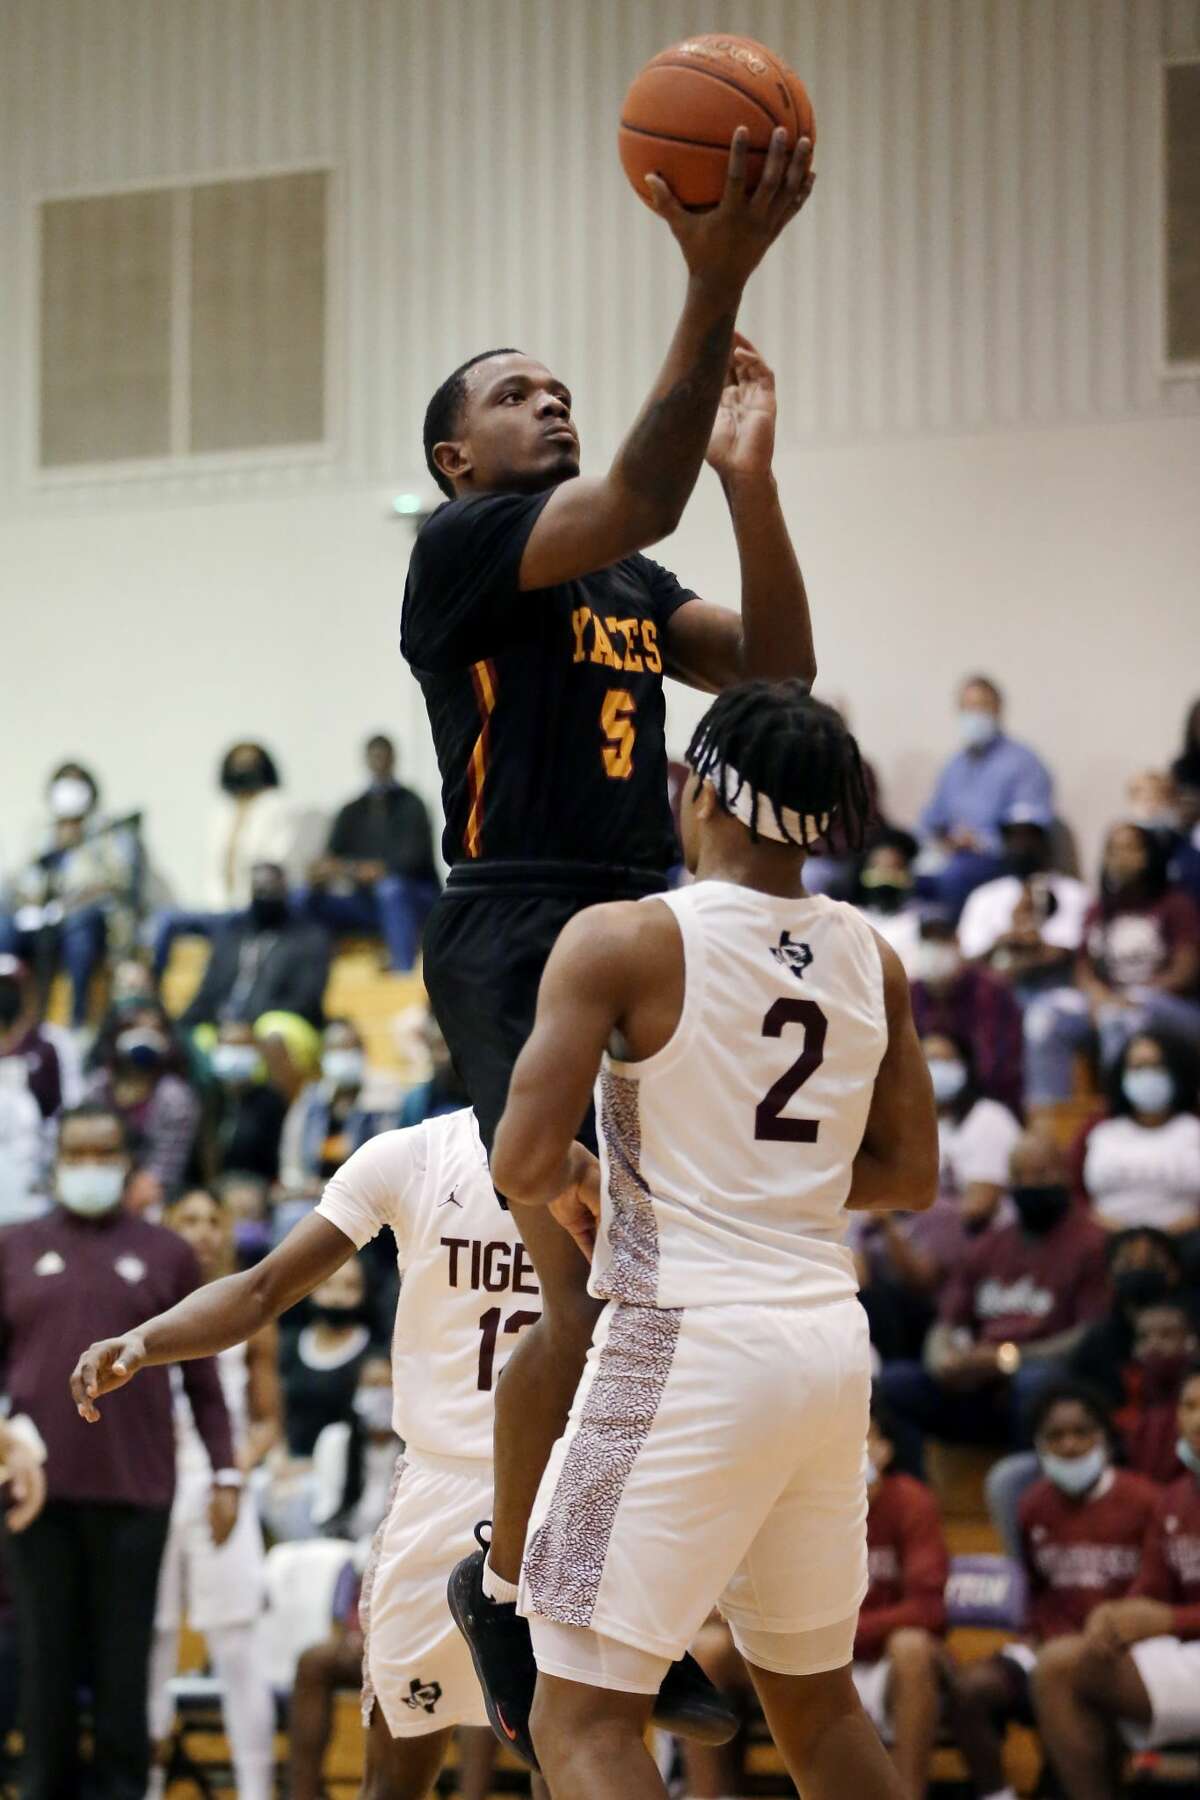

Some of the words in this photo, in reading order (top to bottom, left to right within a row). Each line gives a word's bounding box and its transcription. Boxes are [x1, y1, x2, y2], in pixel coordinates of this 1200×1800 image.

[572, 606, 663, 674] YATES
[600, 688, 636, 779] 5
[755, 997, 828, 1143] 2
